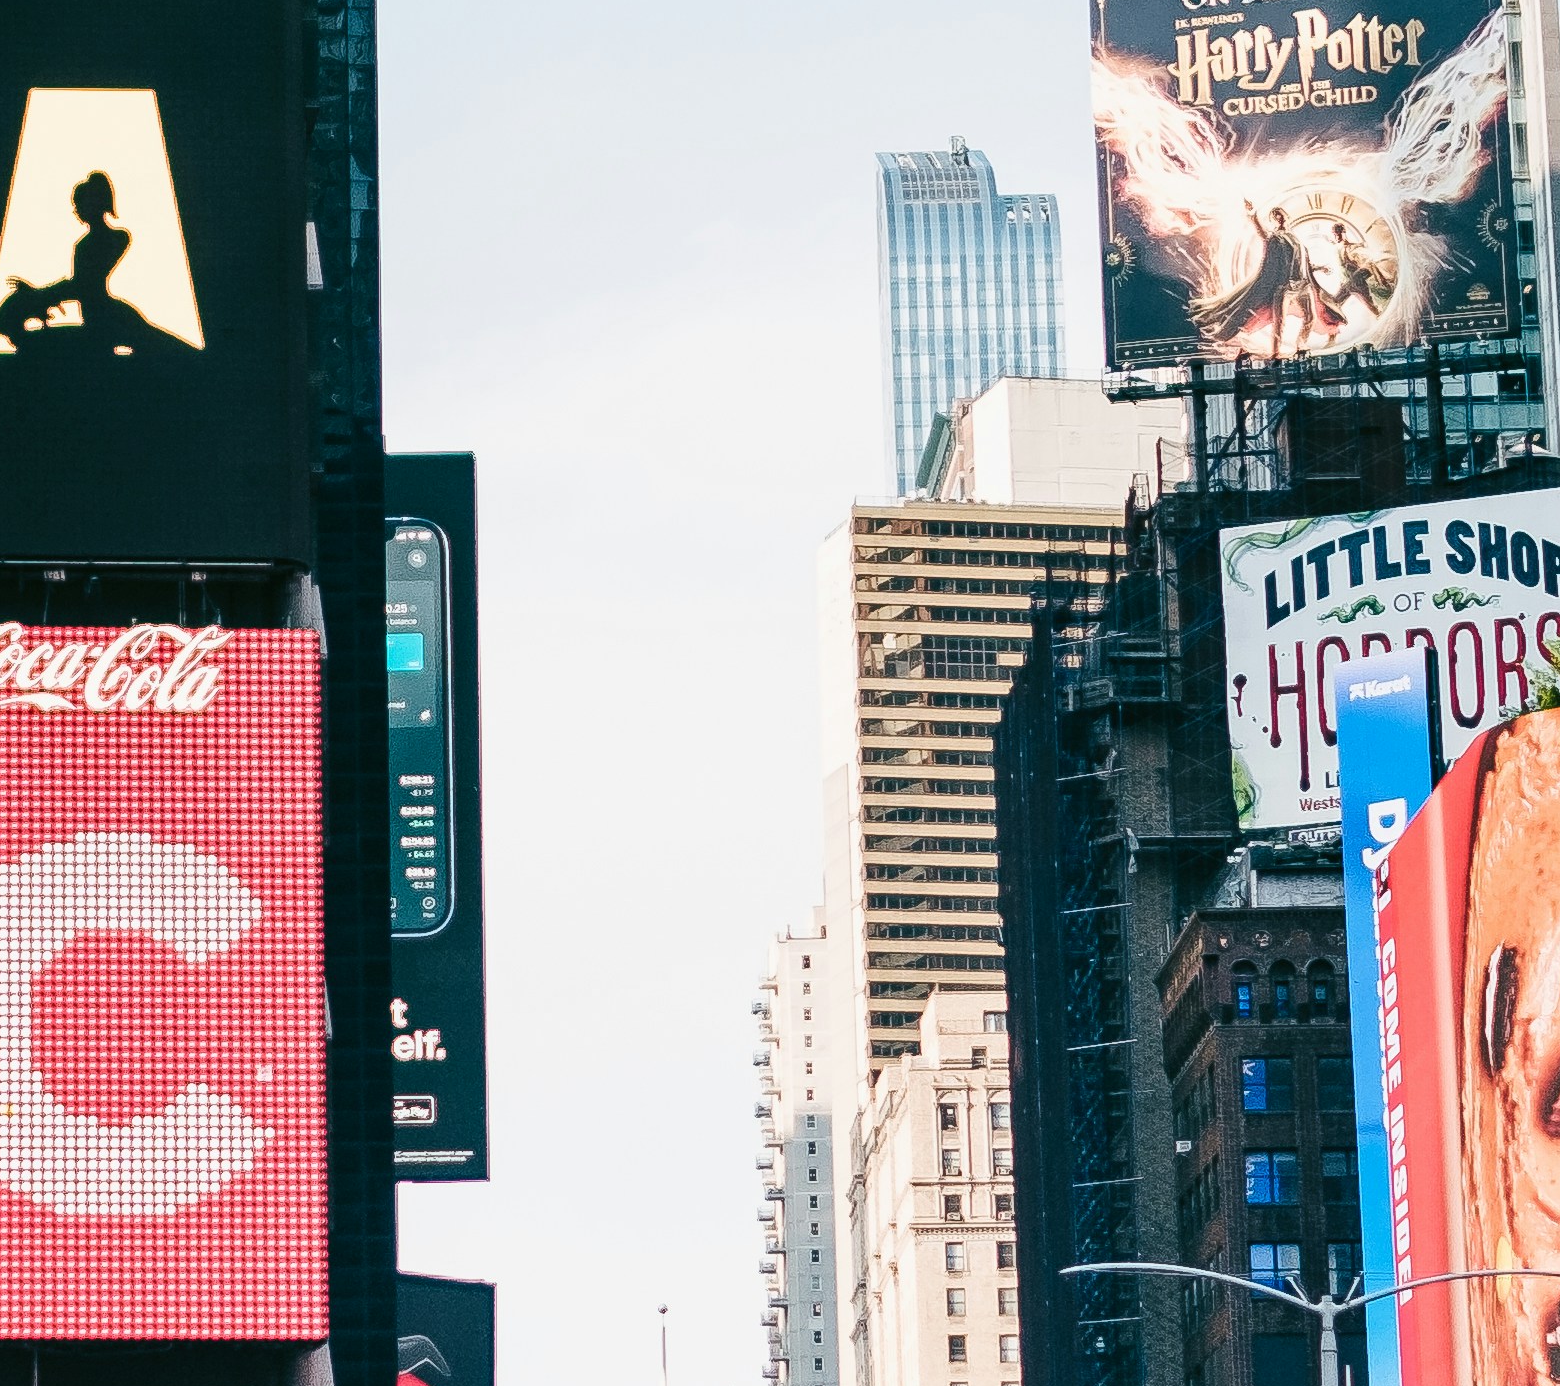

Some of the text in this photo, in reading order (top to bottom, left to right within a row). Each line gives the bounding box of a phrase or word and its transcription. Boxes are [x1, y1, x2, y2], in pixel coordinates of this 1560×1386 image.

[1168, 8, 1426, 106] Harry Potter
[1222, 86, 1378, 115] CURSED CHILD
[1265, 520, 1431, 631] LITTLE
[1394, 591, 1426, 612] OF
